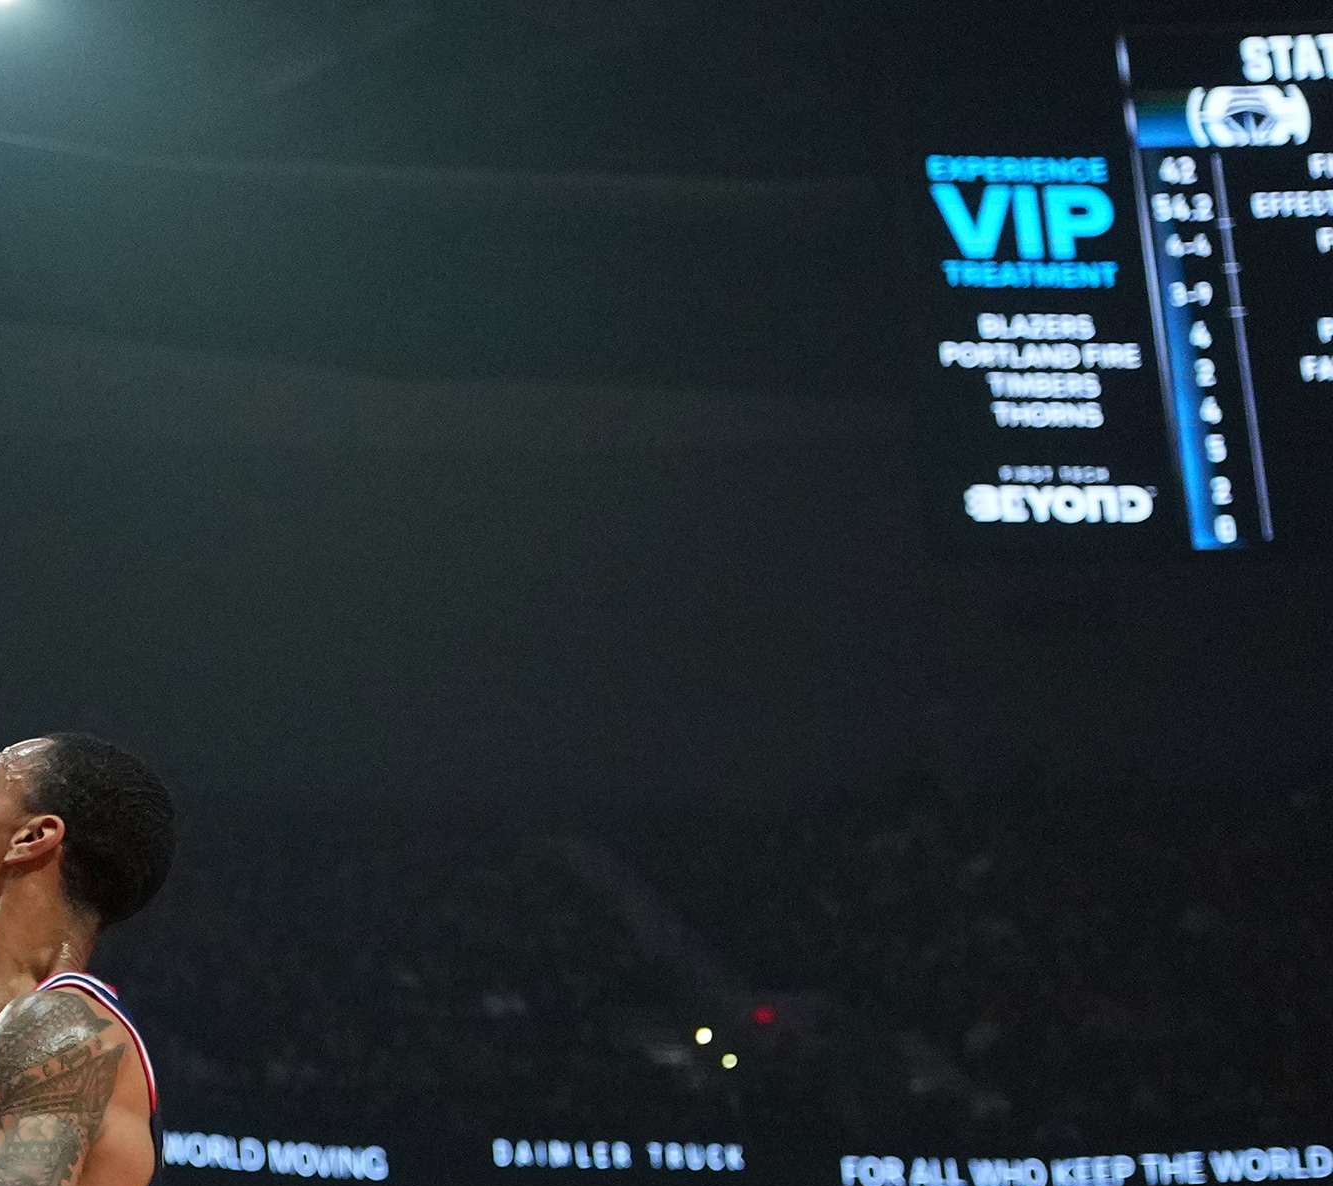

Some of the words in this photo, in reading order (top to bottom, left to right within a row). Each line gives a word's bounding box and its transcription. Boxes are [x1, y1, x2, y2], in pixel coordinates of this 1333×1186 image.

[926, 155, 1109, 184] EXPERIENCE
[930, 183, 1114, 260] VIP
[941, 260, 1118, 288] TREATMENT
[977, 312, 1096, 341] BLAZERS
[938, 341, 1082, 369] PORTLAND
[1083, 342, 1142, 369] FIRE
[985, 371, 1102, 399] TIMBERS
[990, 401, 1104, 428] THORNS
[964, 484, 1153, 523] BEYOND
[267, 1139, 389, 1181] MOVING
[492, 1137, 633, 1169] DAIMLER
[645, 1140, 746, 1171] TRUCK
[1139, 1151, 1208, 1186] THE
[1208, 1145, 1333, 1183] WORLD
